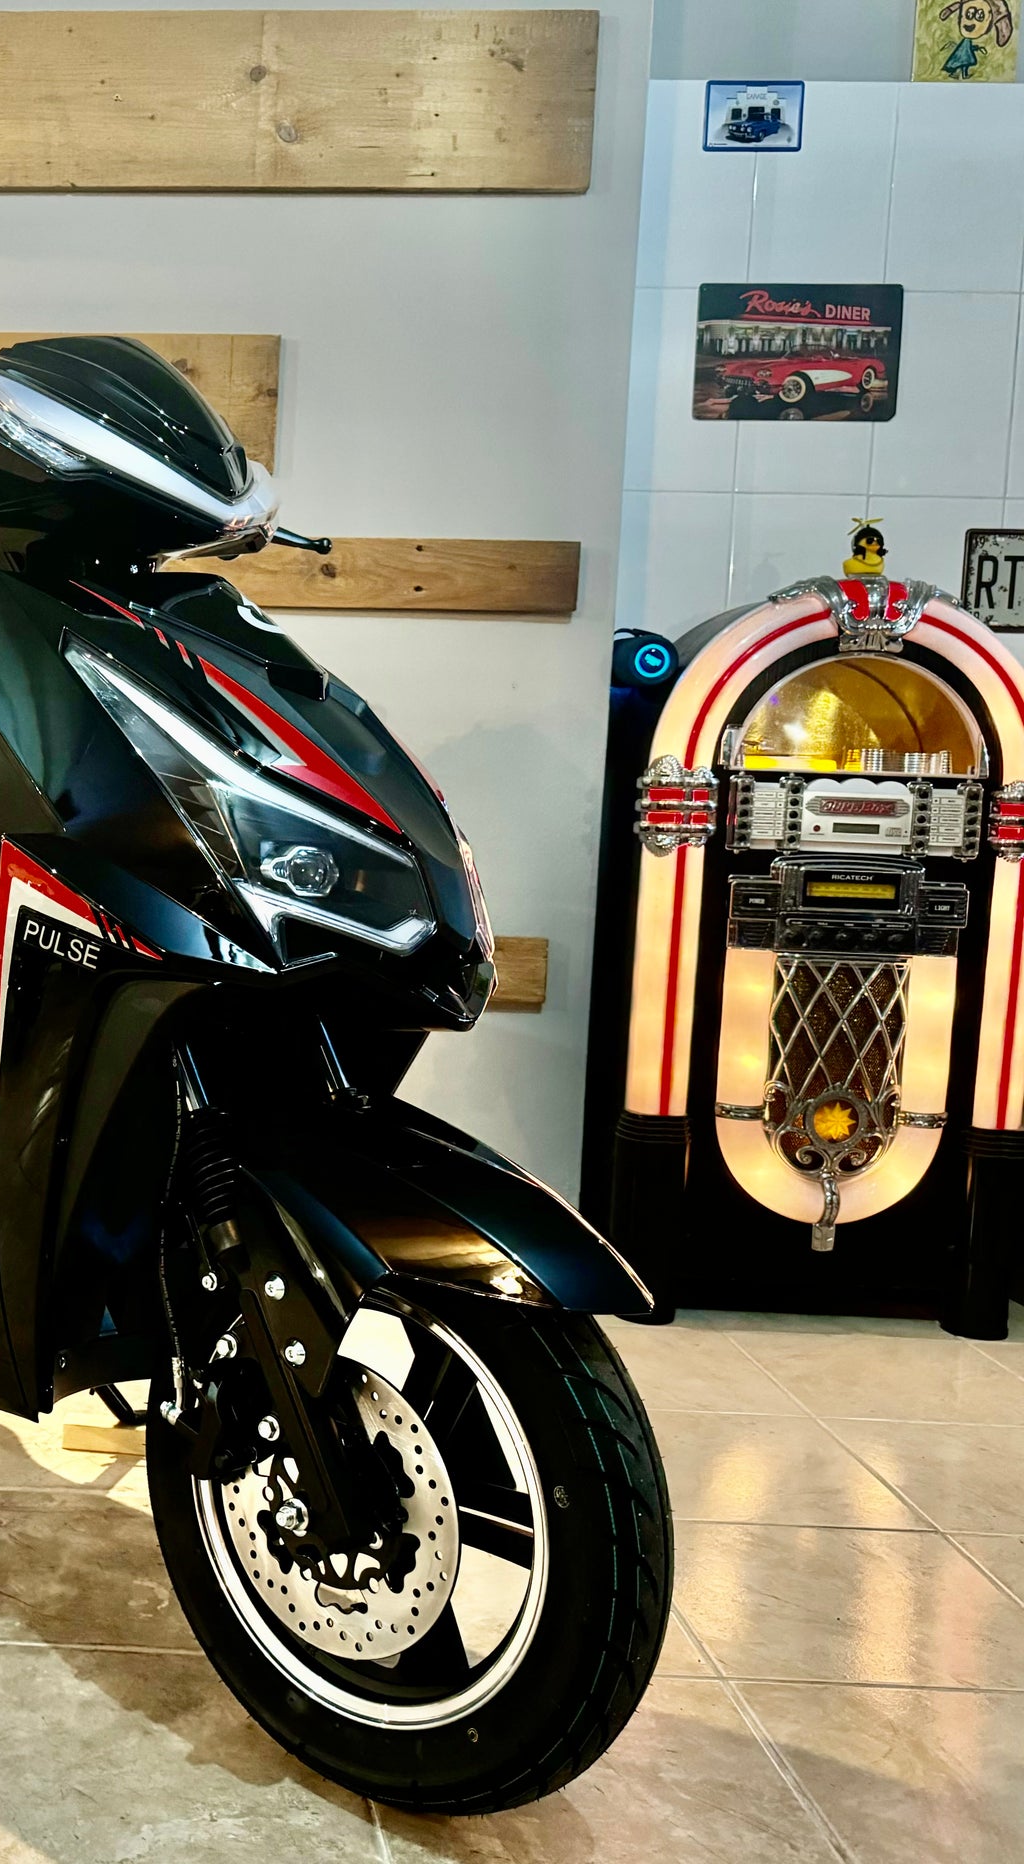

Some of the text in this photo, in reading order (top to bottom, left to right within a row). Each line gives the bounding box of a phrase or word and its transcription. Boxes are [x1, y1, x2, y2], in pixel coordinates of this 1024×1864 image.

[739, 289, 872, 321] Rosie's DINER
[23, 919, 101, 970] PULSE
